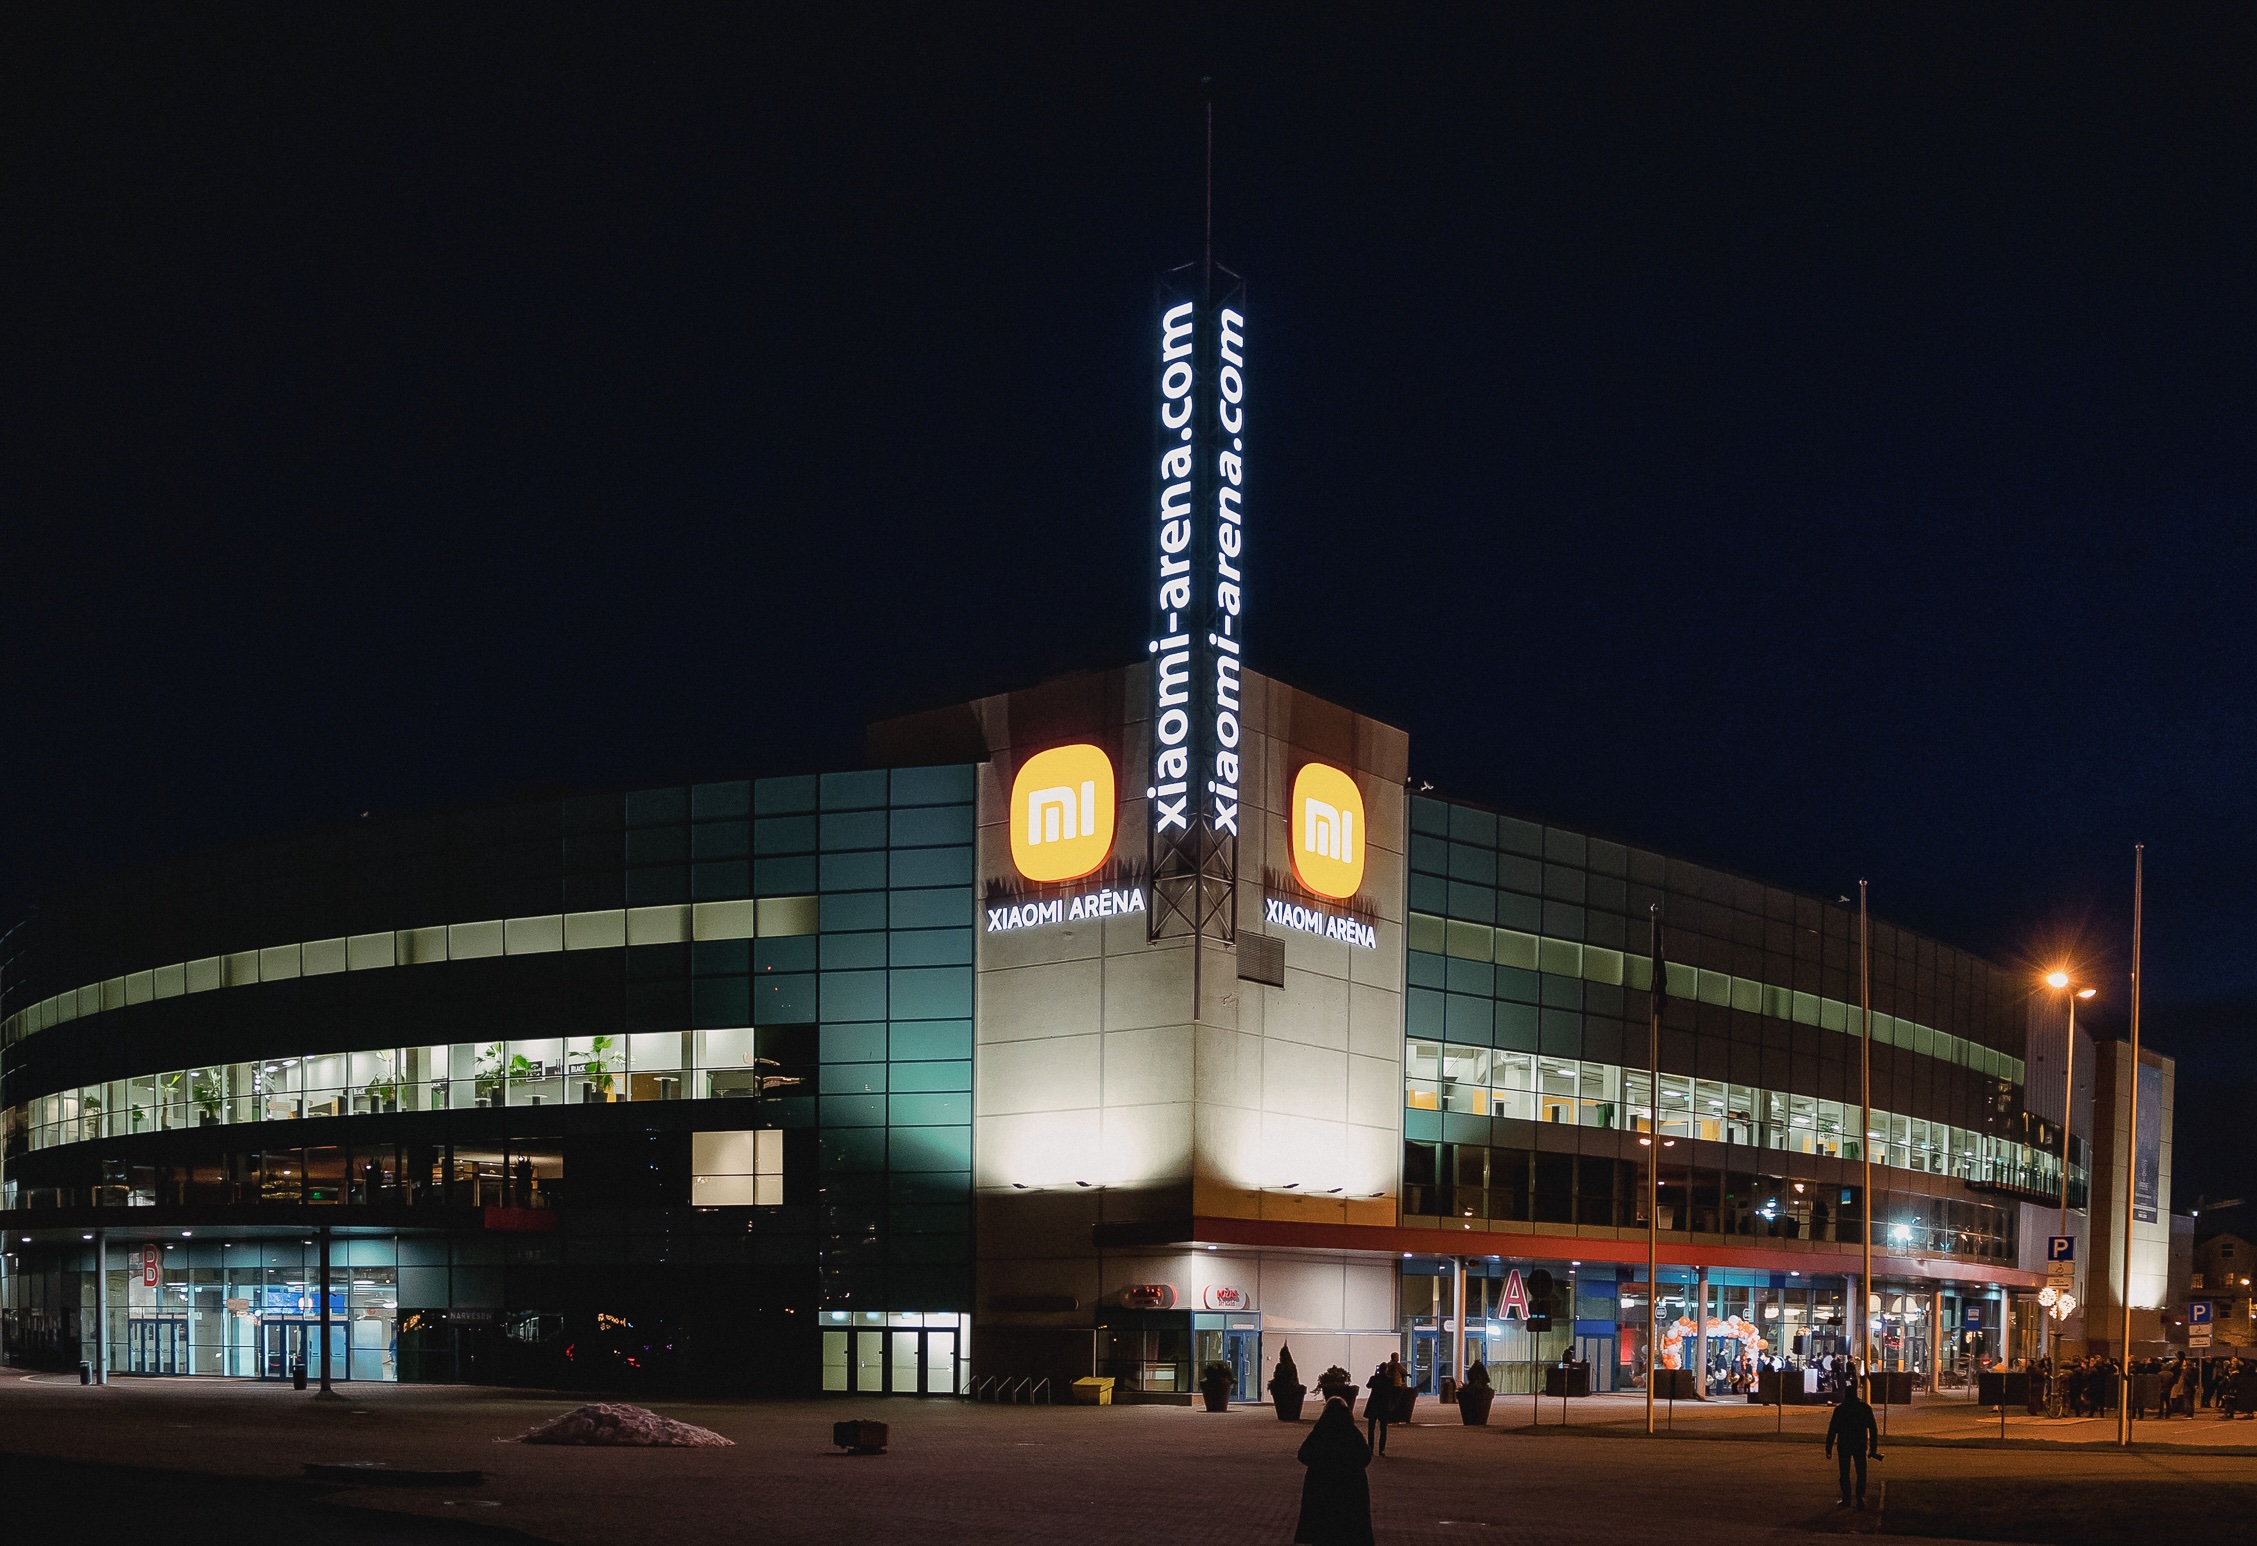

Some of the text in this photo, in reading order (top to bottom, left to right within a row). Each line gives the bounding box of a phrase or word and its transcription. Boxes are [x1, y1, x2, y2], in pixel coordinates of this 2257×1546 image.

[1147, 302, 1193, 833] xiaomi-arena.com
[1208, 308, 1244, 837] xiaomi-arena.com
[987, 888, 1146, 932] XIAOMI ARĒNA
[1266, 898, 1377, 949] XIAOMI ARĒNA
[142, 1243, 160, 1288] B
[2053, 1238, 2069, 1258] P
[1498, 1268, 1531, 1321] A
[2193, 1304, 2206, 1321] P
